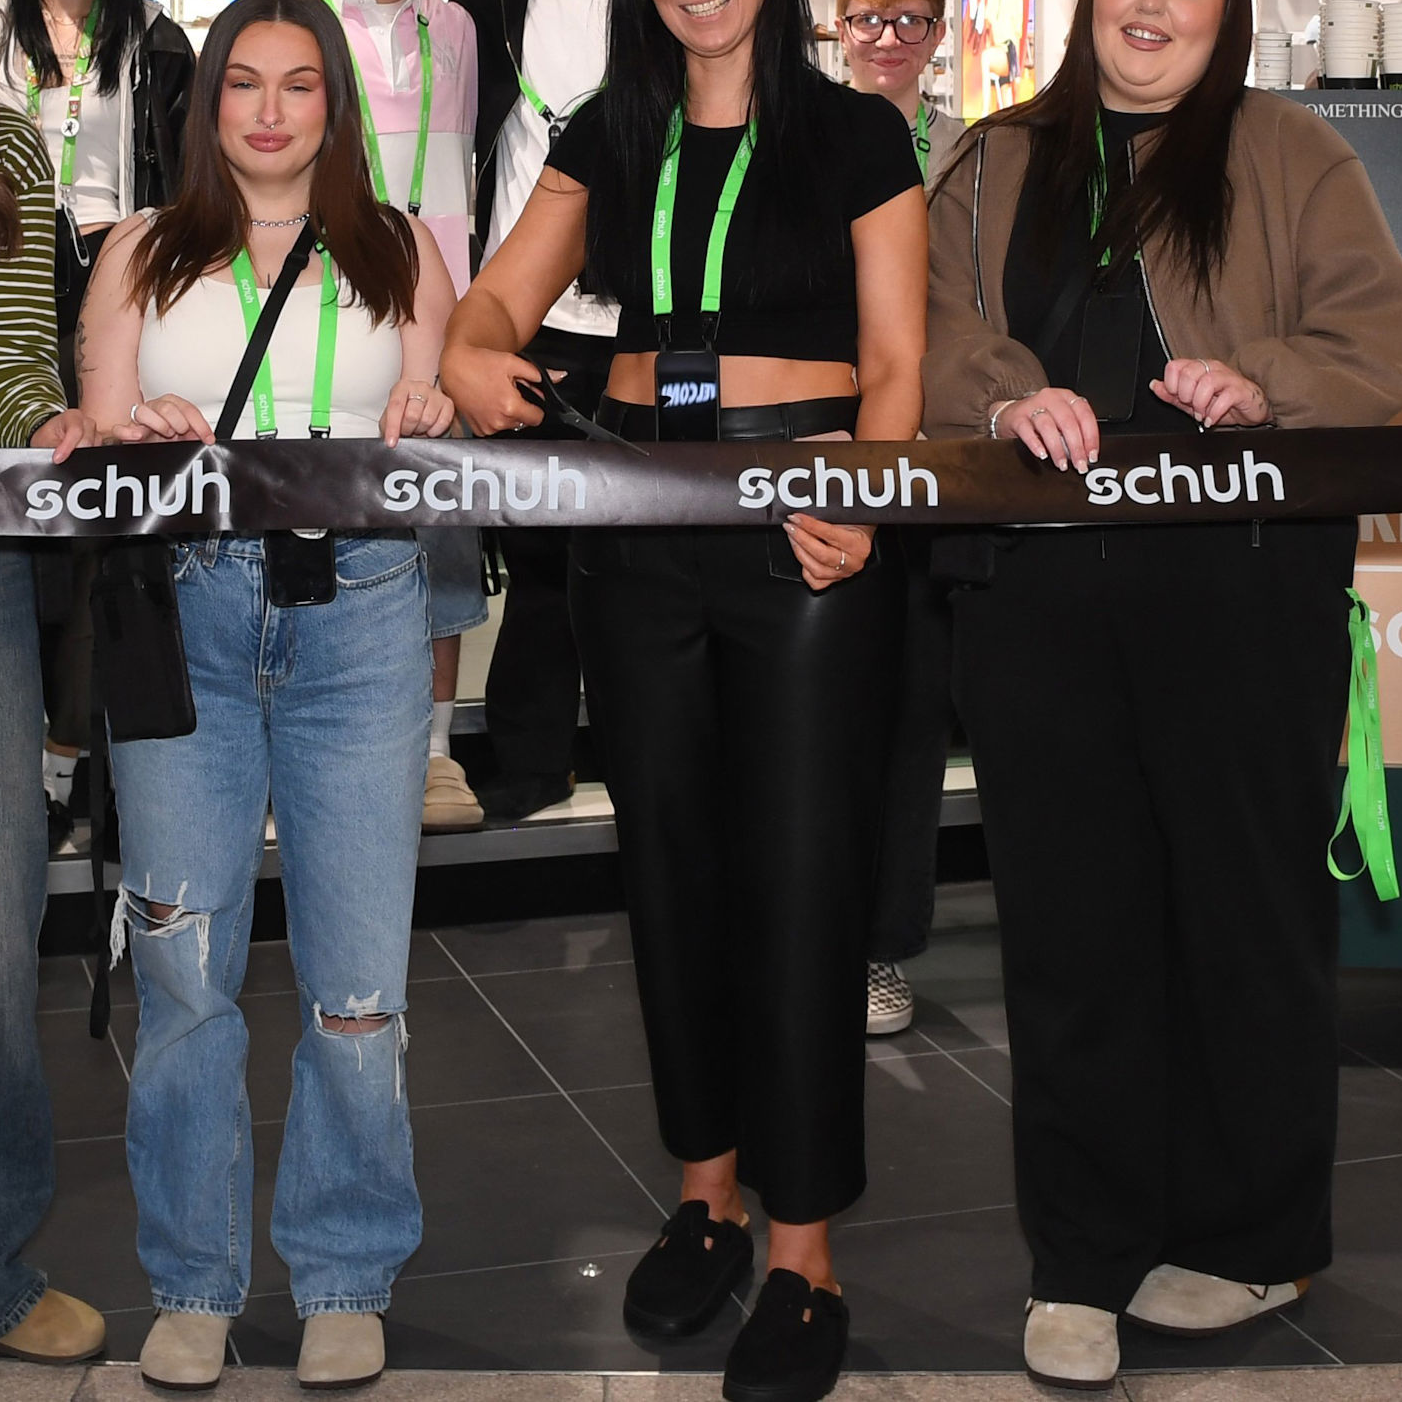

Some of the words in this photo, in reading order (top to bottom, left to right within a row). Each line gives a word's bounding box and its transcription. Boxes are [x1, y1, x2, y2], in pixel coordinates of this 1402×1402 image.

[657, 209, 666, 239] schuh
[241, 278, 255, 304] schuh
[656, 268, 665, 301] schuh
[259, 393, 270, 427] schuh
[25, 459, 231, 520] schuh
[382, 455, 587, 512] schuh
[738, 456, 939, 509] schuh
[1084, 450, 1285, 506] schuh
